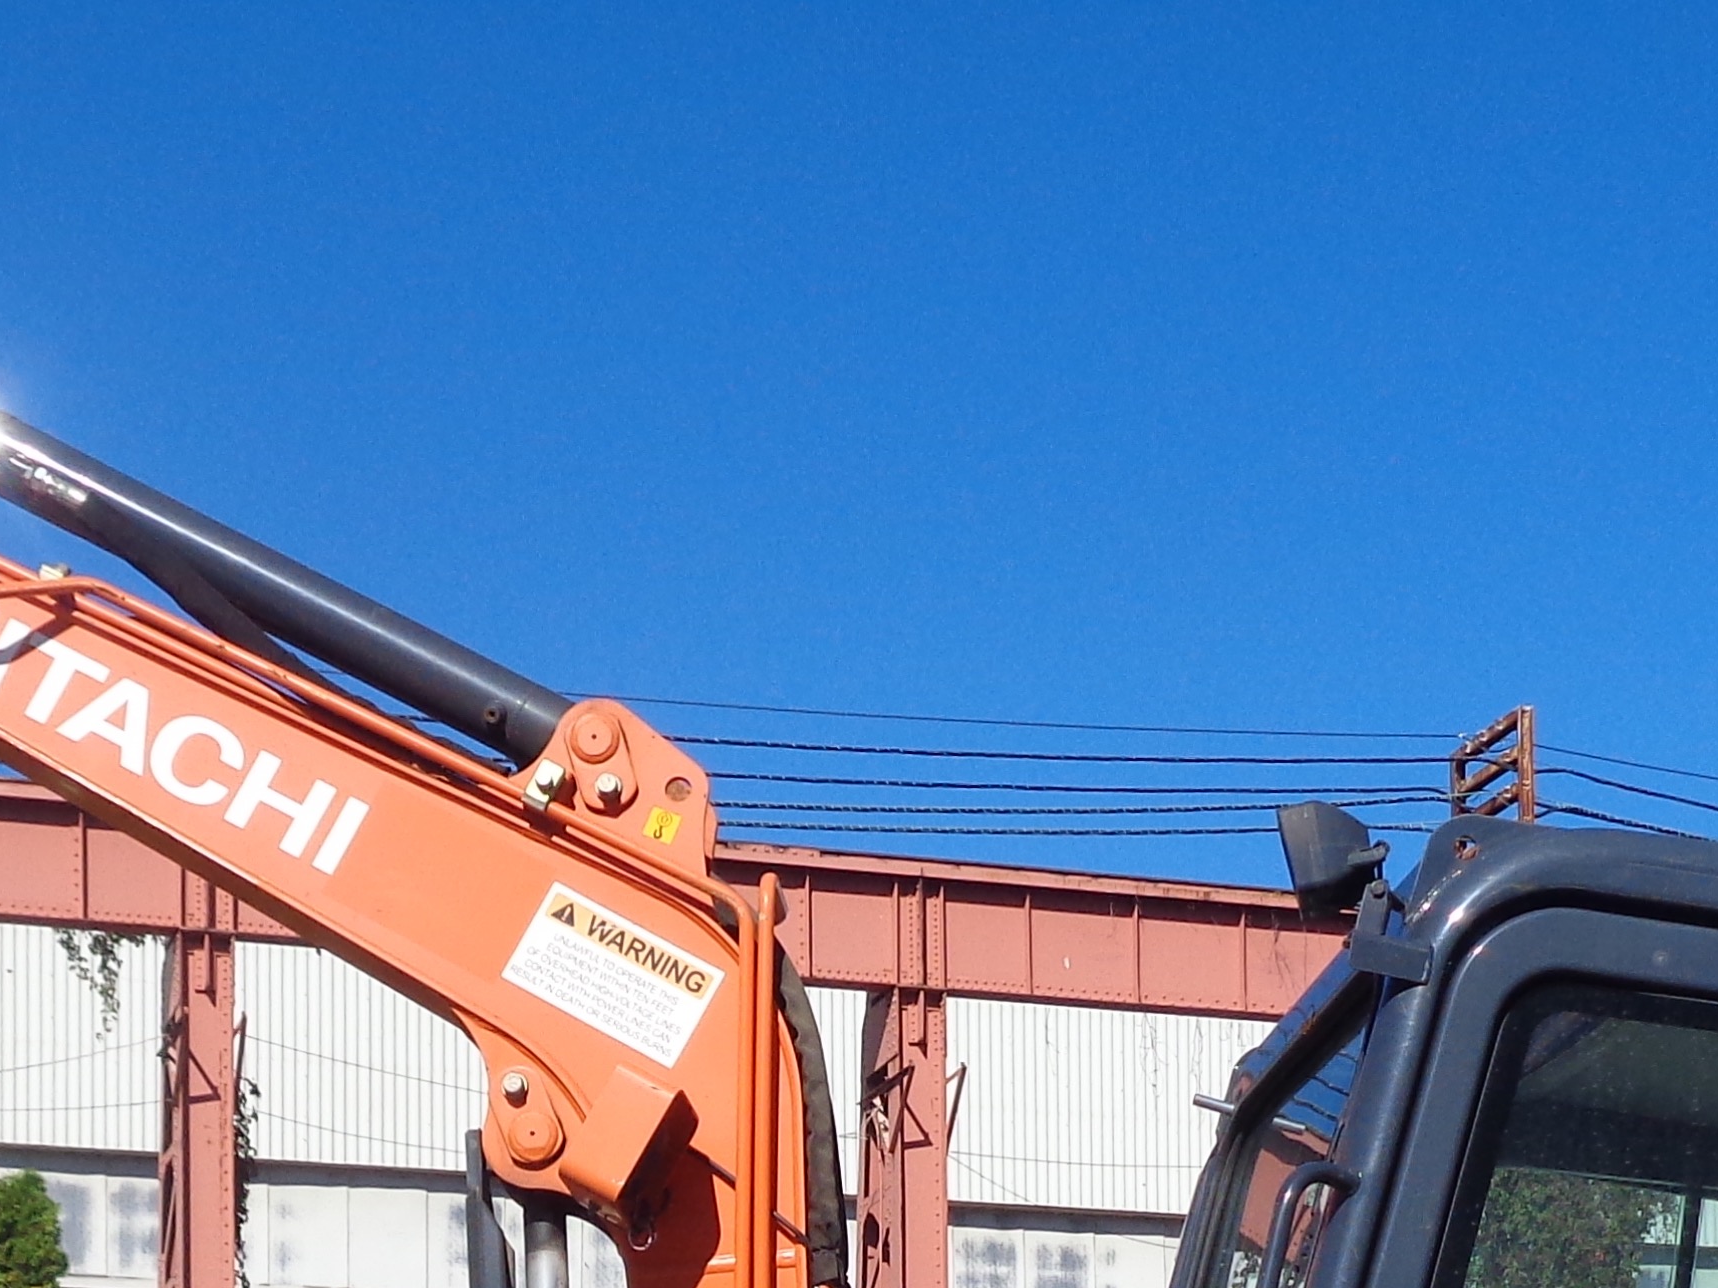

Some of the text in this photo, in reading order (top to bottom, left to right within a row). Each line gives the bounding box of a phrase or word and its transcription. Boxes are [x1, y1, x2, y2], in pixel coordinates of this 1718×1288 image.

[527, 945, 541, 957] OF
[541, 953, 591, 986] OVERHEAD
[655, 1016, 682, 1036] LINES
[546, 941, 676, 1017] EQUIPMENT WITHIN TEN FEET
[553, 932, 680, 1007] UNLAWFUL TO OPERATE THIS
[587, 913, 706, 994] WARNING
[510, 963, 545, 987] RESULT
[555, 990, 585, 1010] DEATH
[586, 1005, 601, 1019] OR
[601, 1013, 640, 1041] SERIOUS
[641, 1035, 673, 1058] BURNS
[524, 958, 672, 1044] CONTACT WITH POWER LINES CAN
